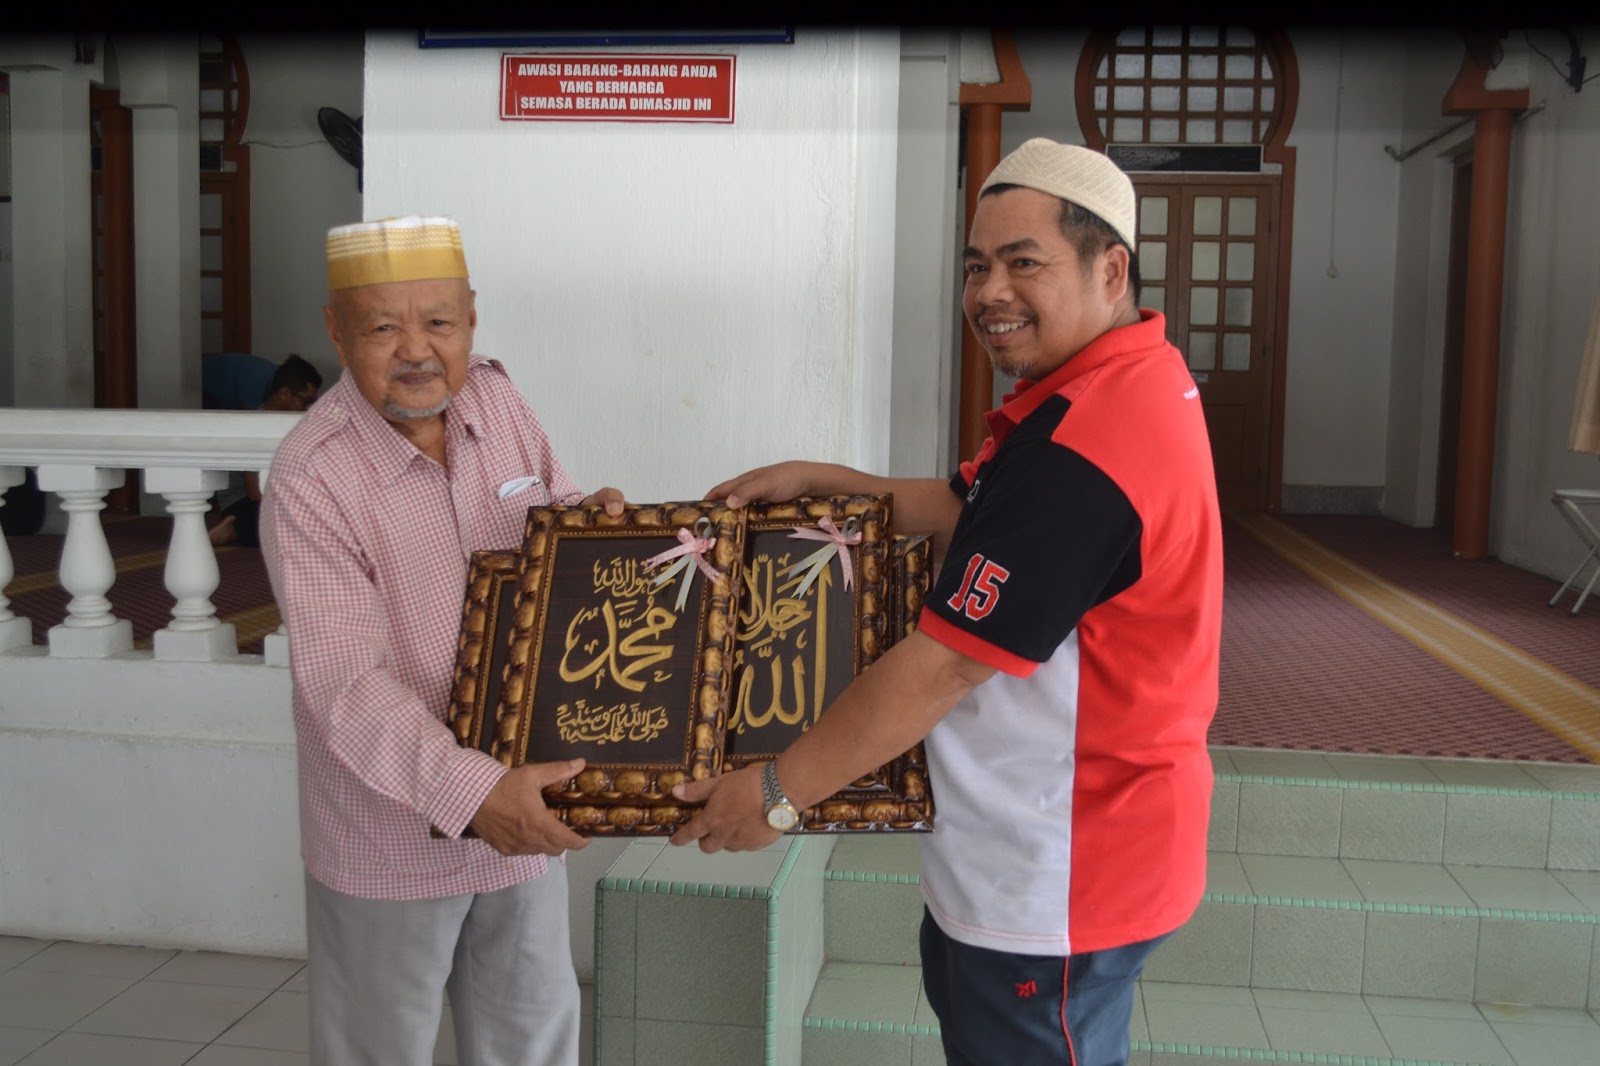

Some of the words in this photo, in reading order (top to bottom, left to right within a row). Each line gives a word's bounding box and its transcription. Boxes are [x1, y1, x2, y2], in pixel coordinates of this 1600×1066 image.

[518, 64, 561, 77] AWASI
[564, 64, 678, 78] BARANG-BARANG
[681, 65, 718, 79] ANDA
[560, 81, 593, 94] YANG
[595, 81, 665, 94] BERHARGA
[520, 97, 574, 110] SEMASA
[576, 97, 627, 110] BERADA
[629, 98, 692, 111] DIMASJID
[693, 98, 712, 111] INI
[947, 552, 1010, 622] 15
